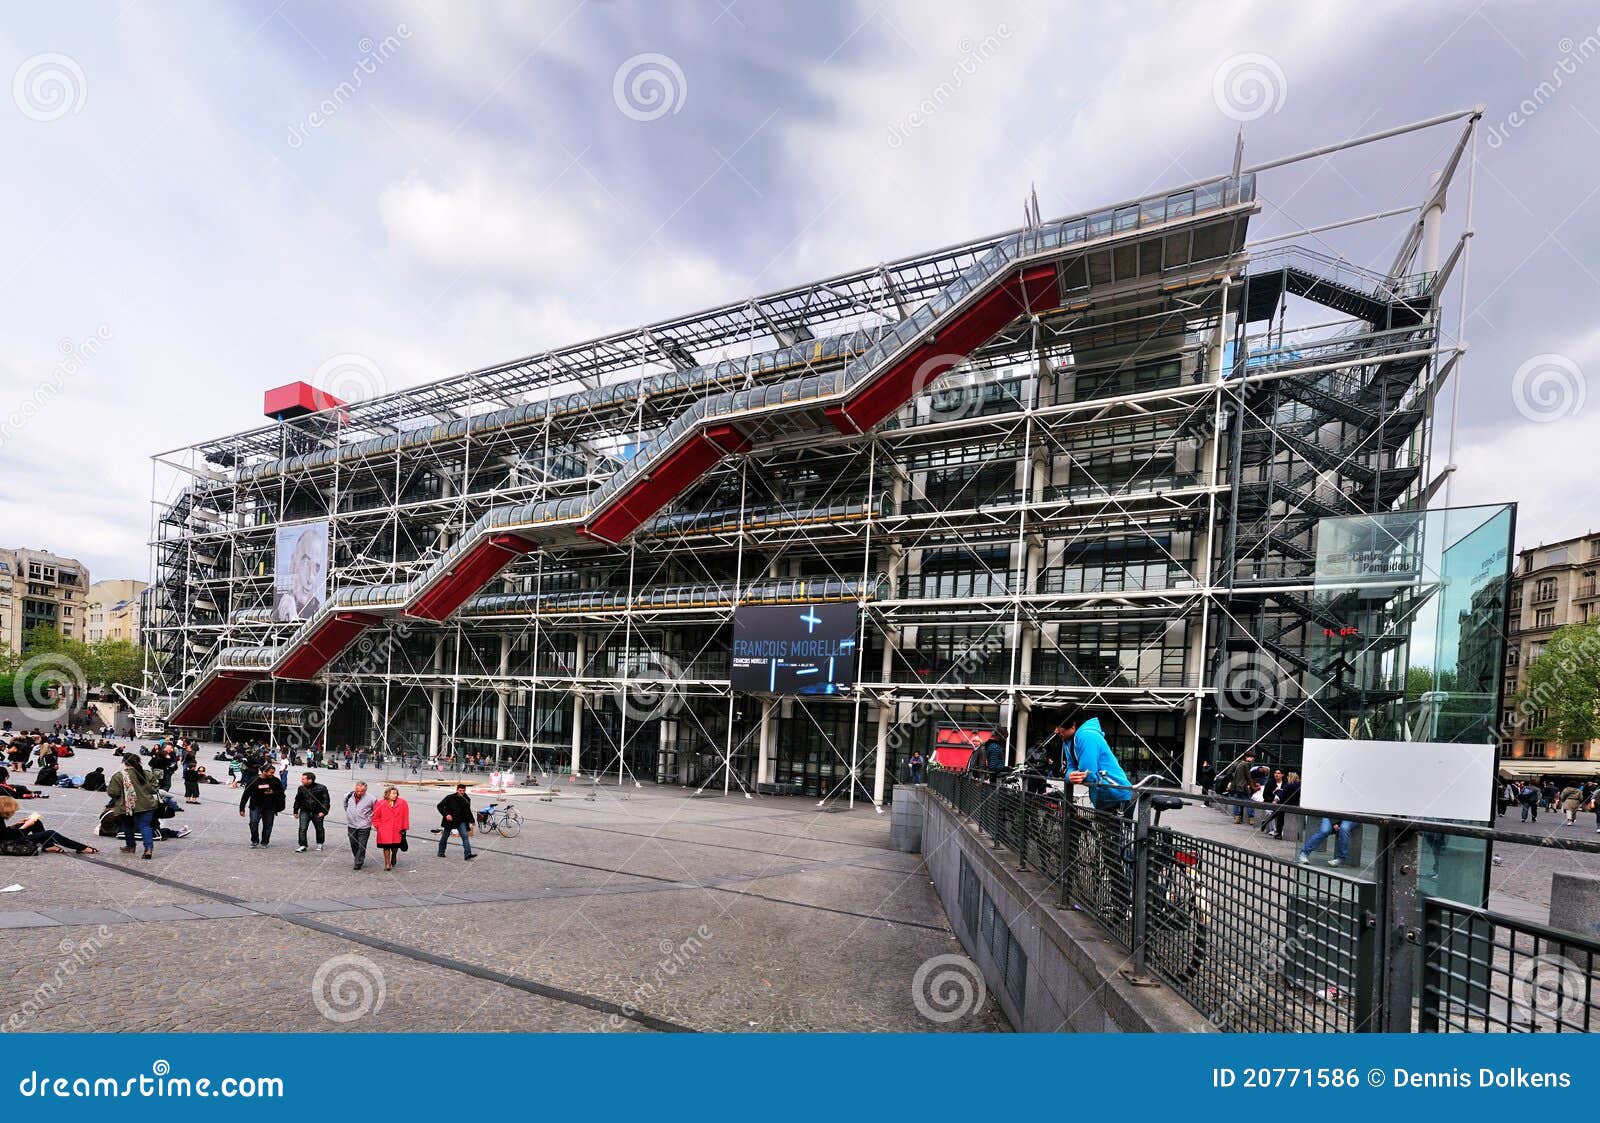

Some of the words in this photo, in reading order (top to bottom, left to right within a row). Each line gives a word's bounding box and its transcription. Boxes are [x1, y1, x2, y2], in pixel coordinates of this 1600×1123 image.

[1352, 551, 1384, 562] Centre
[1363, 561, 1410, 573] Pompidou
[792, 639, 855, 656] MORELLET
